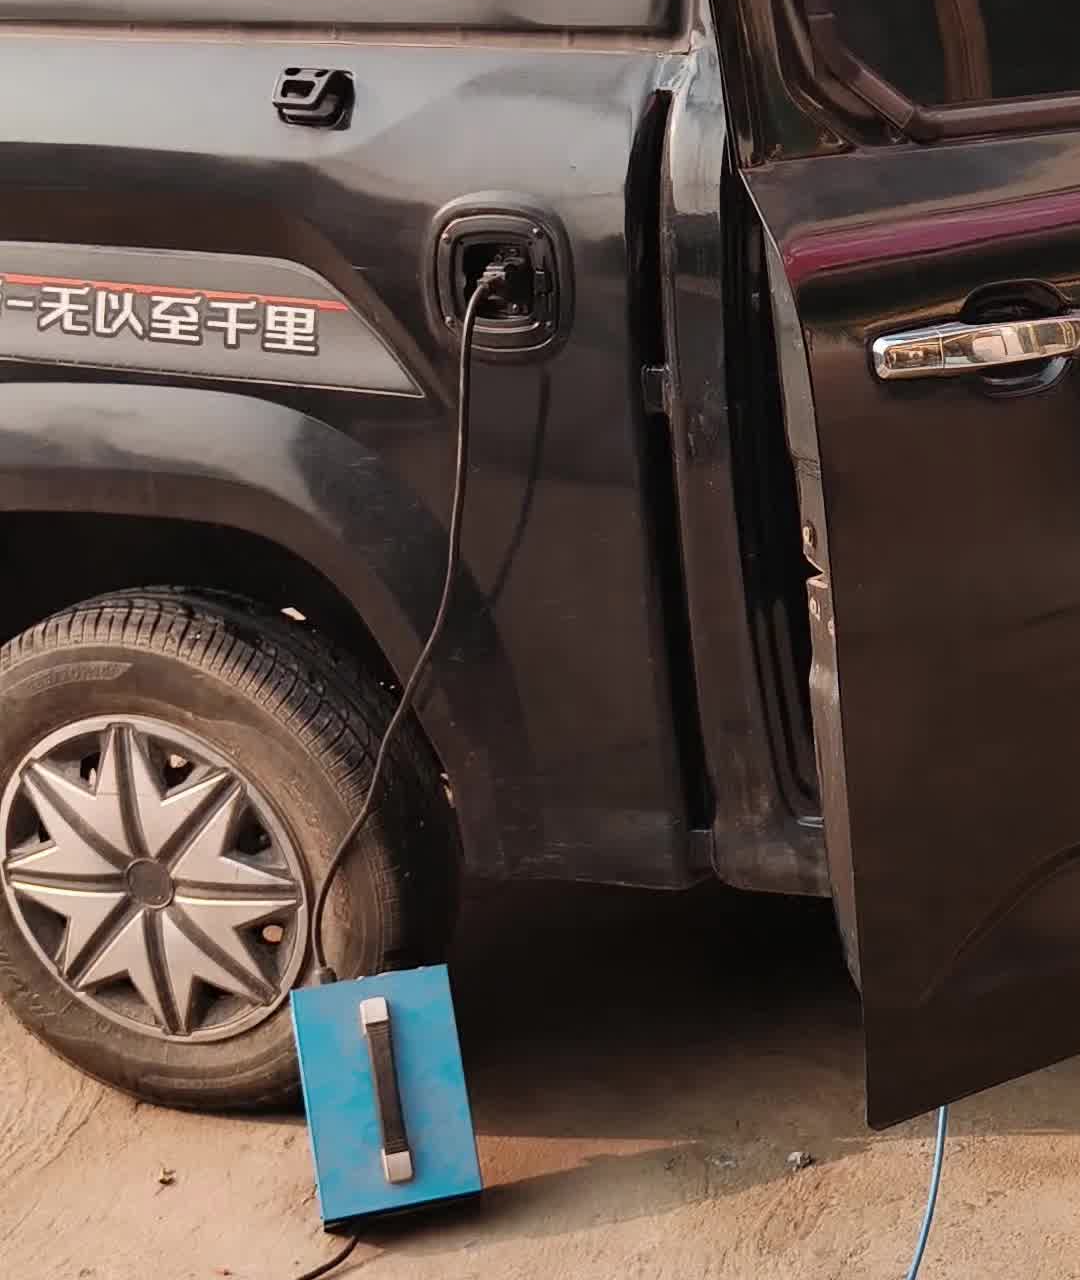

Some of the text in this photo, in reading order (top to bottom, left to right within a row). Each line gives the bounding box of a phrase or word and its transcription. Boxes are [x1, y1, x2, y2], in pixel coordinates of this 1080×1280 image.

[0, 280, 317, 353] -无以至千里
